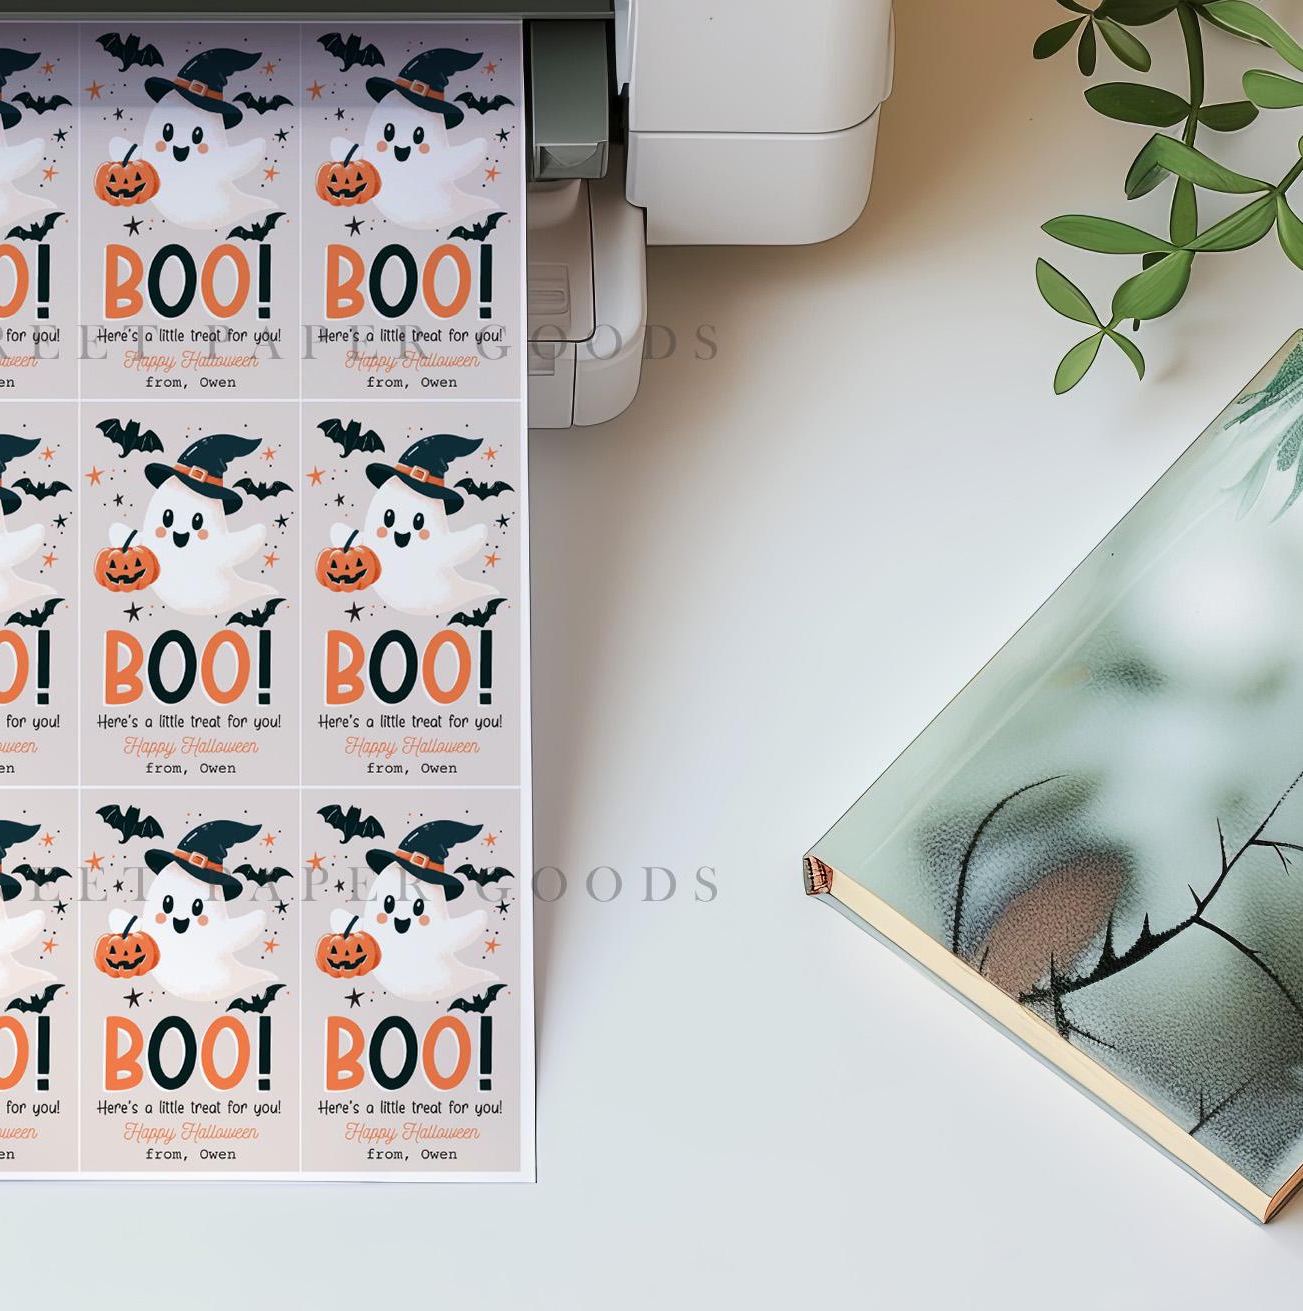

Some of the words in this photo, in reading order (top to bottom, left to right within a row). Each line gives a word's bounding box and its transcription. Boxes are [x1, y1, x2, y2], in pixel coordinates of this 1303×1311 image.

[104, 243, 271, 319] BOO!
[326, 243, 493, 319] BOO!
[6, 328, 26, 342] for
[32, 328, 60, 345] you!
[96, 328, 138, 344] Here's
[144, 331, 153, 342] a
[158, 328, 184, 342] little
[190, 328, 221, 342] treat
[227, 328, 247, 342] for
[253, 328, 281, 345] you!
[318, 328, 360, 344] Here's
[366, 331, 375, 342] a
[380, 328, 406, 342] little
[412, 328, 443, 342] treat
[449, 328, 469, 342] for
[475, 328, 503, 345] you!
[122, 350, 176, 373] Happy
[180, 350, 259, 372] Halloween
[344, 350, 398, 373] Happy
[402, 350, 481, 372] Halloween
[145, 377, 188, 389] from,
[199, 377, 236, 388] Owen
[367, 377, 410, 389] from,
[421, 377, 458, 388] Owen
[104, 629, 271, 705] BOO!
[326, 629, 493, 705] BOO!
[6, 714, 26, 728] for
[32, 714, 60, 731] you!
[96, 714, 138, 730] Here's
[144, 717, 153, 728] a
[158, 714, 184, 728] little
[190, 714, 221, 728] treat
[227, 714, 247, 728] for
[253, 714, 281, 731] you!
[318, 714, 360, 730] Here's
[366, 717, 375, 728] a
[380, 714, 406, 728] little
[412, 714, 443, 728] treat
[449, 714, 469, 728] for
[475, 714, 503, 731] you!
[122, 736, 176, 759] Happy
[180, 736, 259, 758] Halloween
[344, 736, 398, 759] Happy
[402, 736, 481, 758] Halloween
[145, 763, 188, 775] from,
[199, 763, 236, 774] Owen
[367, 763, 410, 775] from,
[421, 763, 458, 774] Owen
[104, 1015, 271, 1091] BOO!
[326, 1015, 493, 1091] BOO!
[6, 1100, 26, 1114] for
[32, 1100, 60, 1117] you!
[96, 1100, 138, 1116] Here's
[144, 1103, 153, 1114] a
[158, 1100, 184, 1114] little
[190, 1100, 221, 1114] treat
[227, 1100, 247, 1114] for
[253, 1100, 281, 1117] you!
[318, 1100, 360, 1116] Here's
[366, 1103, 375, 1114] a
[380, 1100, 406, 1114] little
[412, 1100, 443, 1114] treat
[449, 1100, 469, 1114] for
[475, 1100, 503, 1117] you!
[122, 1122, 176, 1145] Happy
[180, 1122, 259, 1144] Halloween
[344, 1122, 398, 1145] Happy
[402, 1122, 481, 1144] Halloween
[145, 1149, 188, 1161] from,
[199, 1149, 236, 1160] Owen
[367, 1149, 410, 1161] from,
[421, 1149, 458, 1160] Owen
